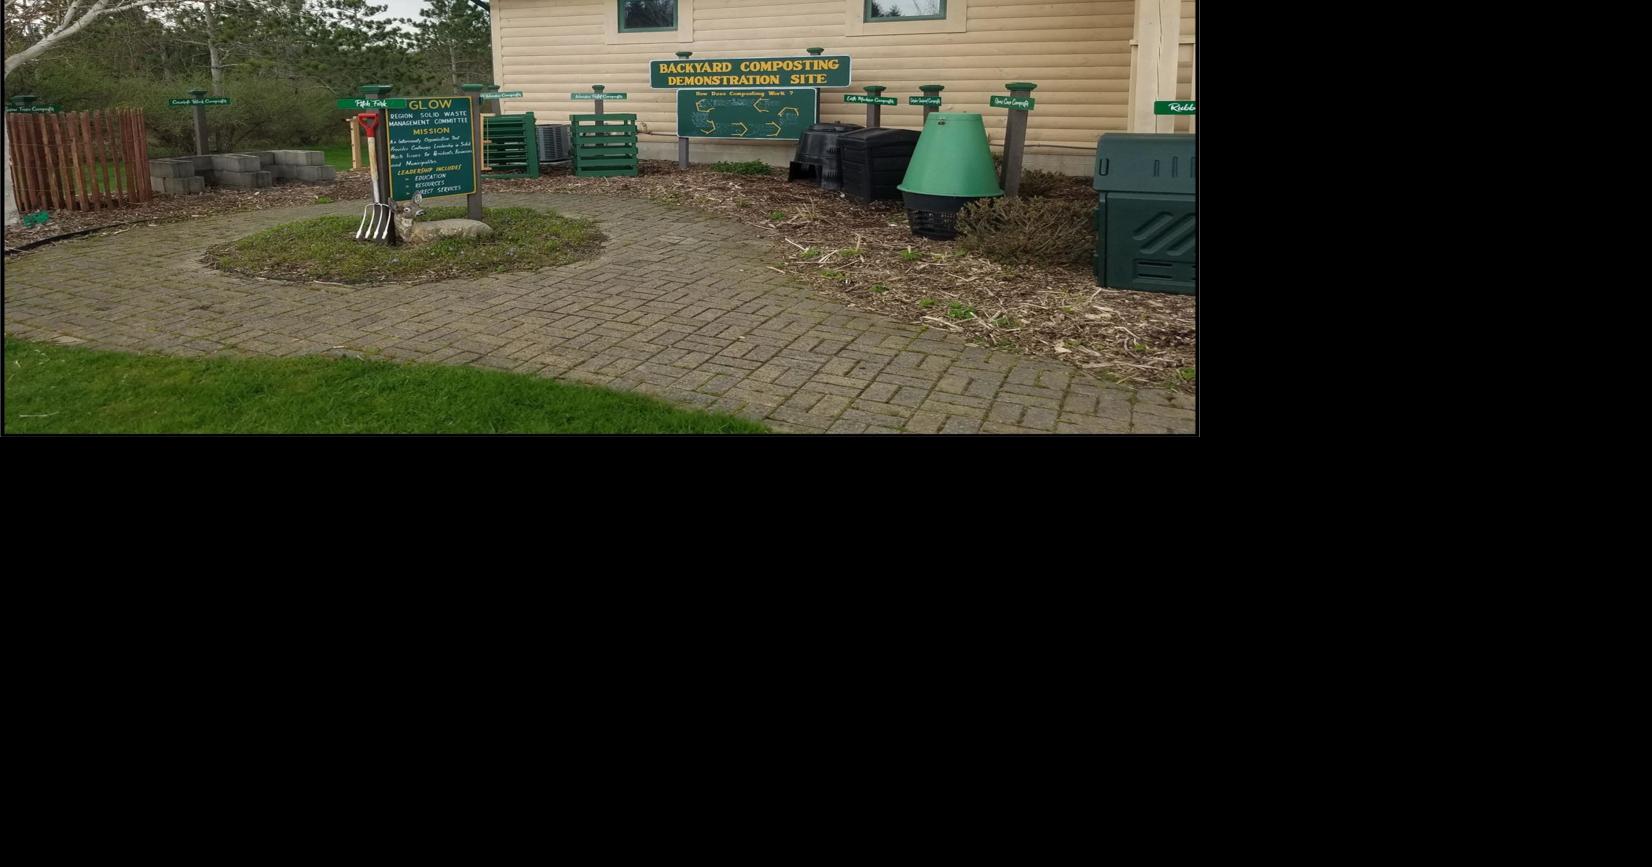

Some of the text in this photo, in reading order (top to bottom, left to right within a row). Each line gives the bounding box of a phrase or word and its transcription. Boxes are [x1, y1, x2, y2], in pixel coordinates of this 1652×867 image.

[659, 59, 839, 74] BACKYARD COMPOSTING
[668, 73, 827, 86] DEMONSTRATION SITE
[408, 99, 452, 110] GLOW
[389, 117, 468, 127] MANAGEMENT COMMITTEE
[413, 127, 450, 135] MISSION
[397, 164, 462, 176] LEADERSHIP INCLUDES
[415, 173, 447, 181] EDUCATION
[415, 180, 445, 188] RESOURCES
[437, 185, 462, 193] SERVICES
